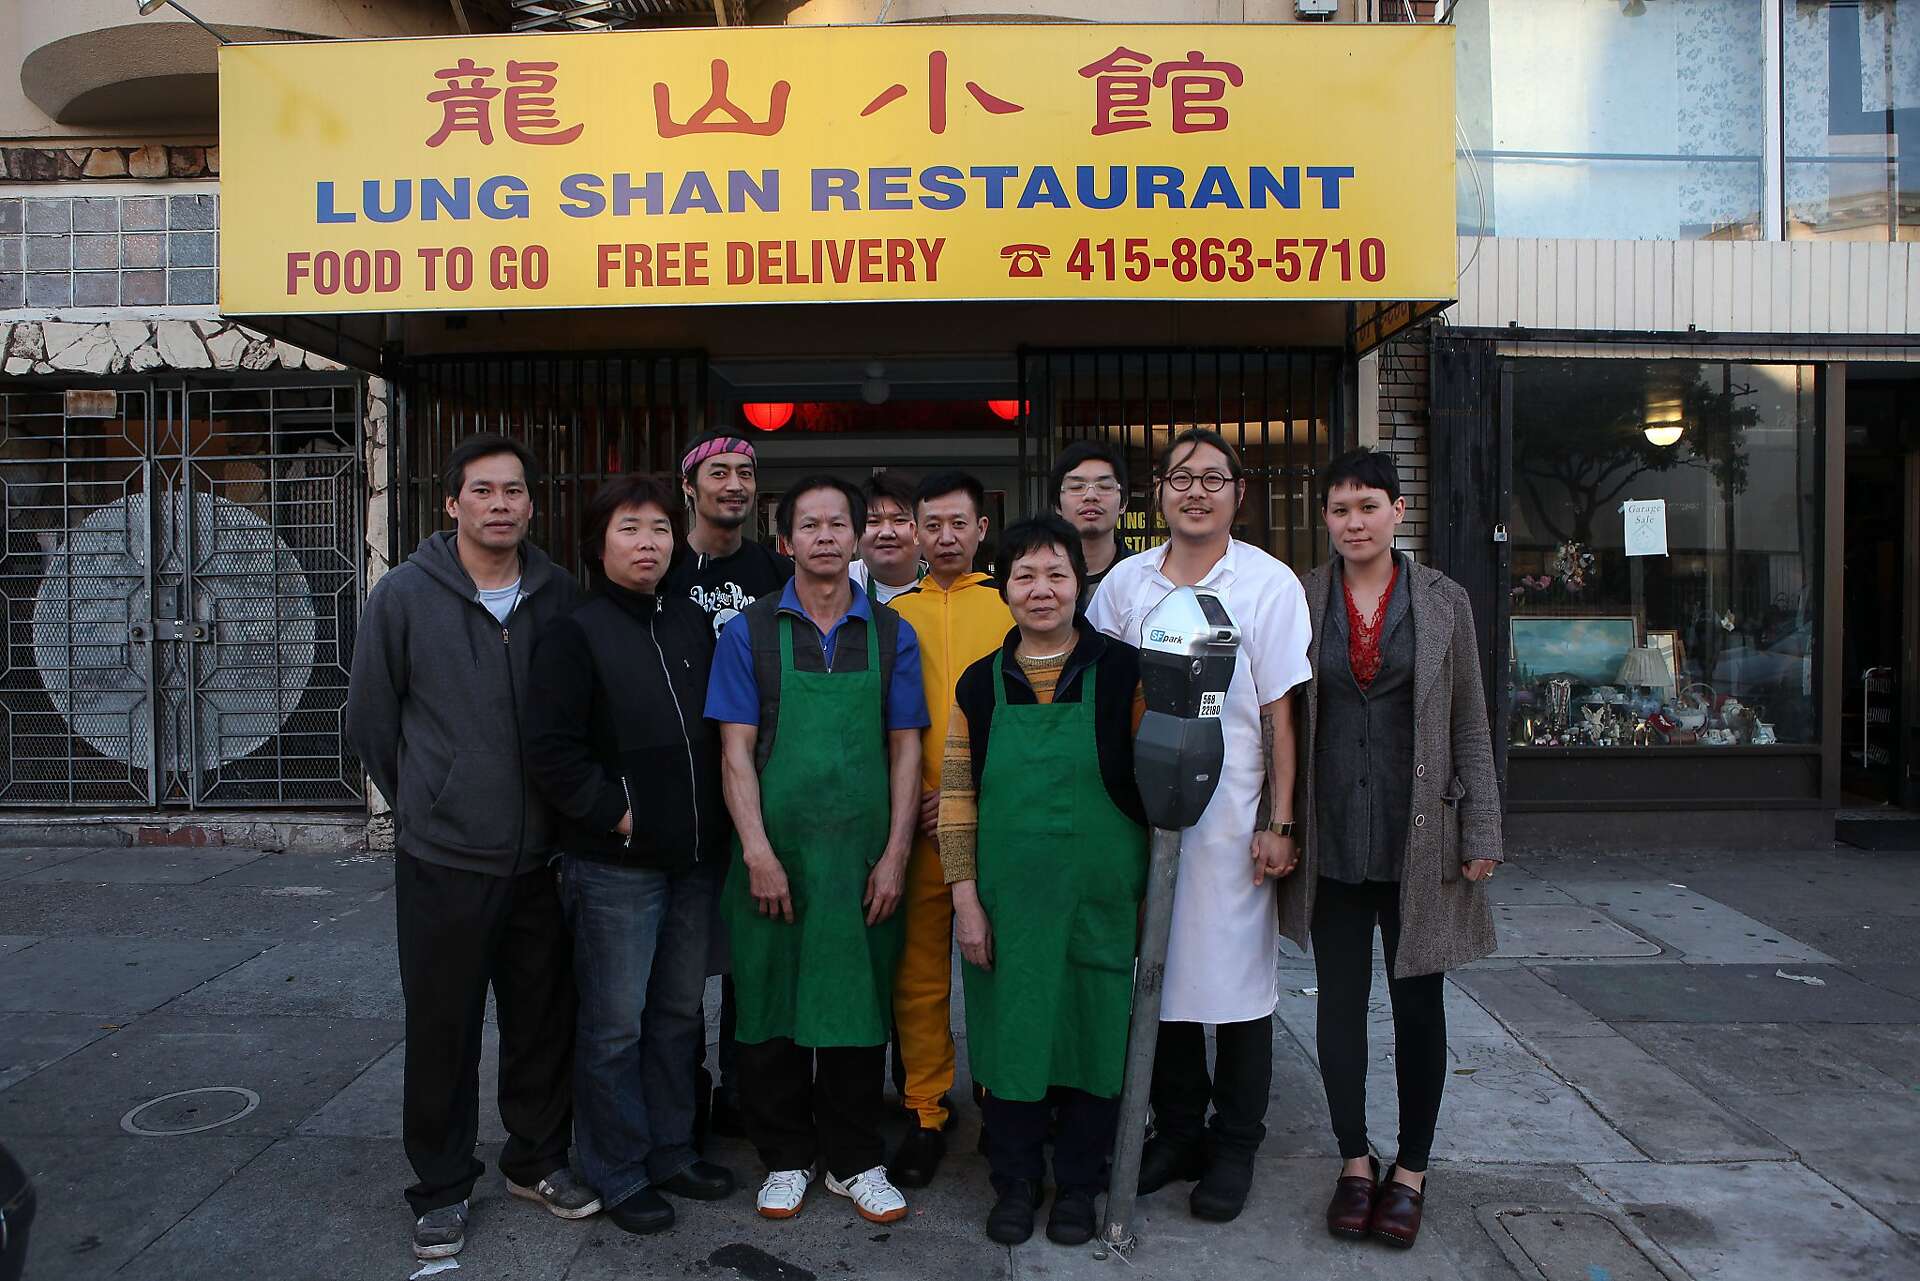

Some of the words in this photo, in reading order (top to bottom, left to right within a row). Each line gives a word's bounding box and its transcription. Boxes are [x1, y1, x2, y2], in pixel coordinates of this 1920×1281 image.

[427, 47, 1244, 147] 龍山小館
[316, 176, 529, 224] LUNG
[560, 170, 778, 217] SHAN
[812, 165, 1355, 211] RESTAURANT
[287, 250, 401, 294] FOOD
[418, 247, 474, 291] TO
[490, 244, 549, 290] GO
[597, 241, 710, 288] FREE
[727, 237, 946, 287] DELIVERY
[1067, 236, 1386, 284] 415-863-5710
[1628, 504, 1662, 514] Garage
[1635, 514, 1655, 525] Sale
[1201, 705, 1220, 716] 22180
